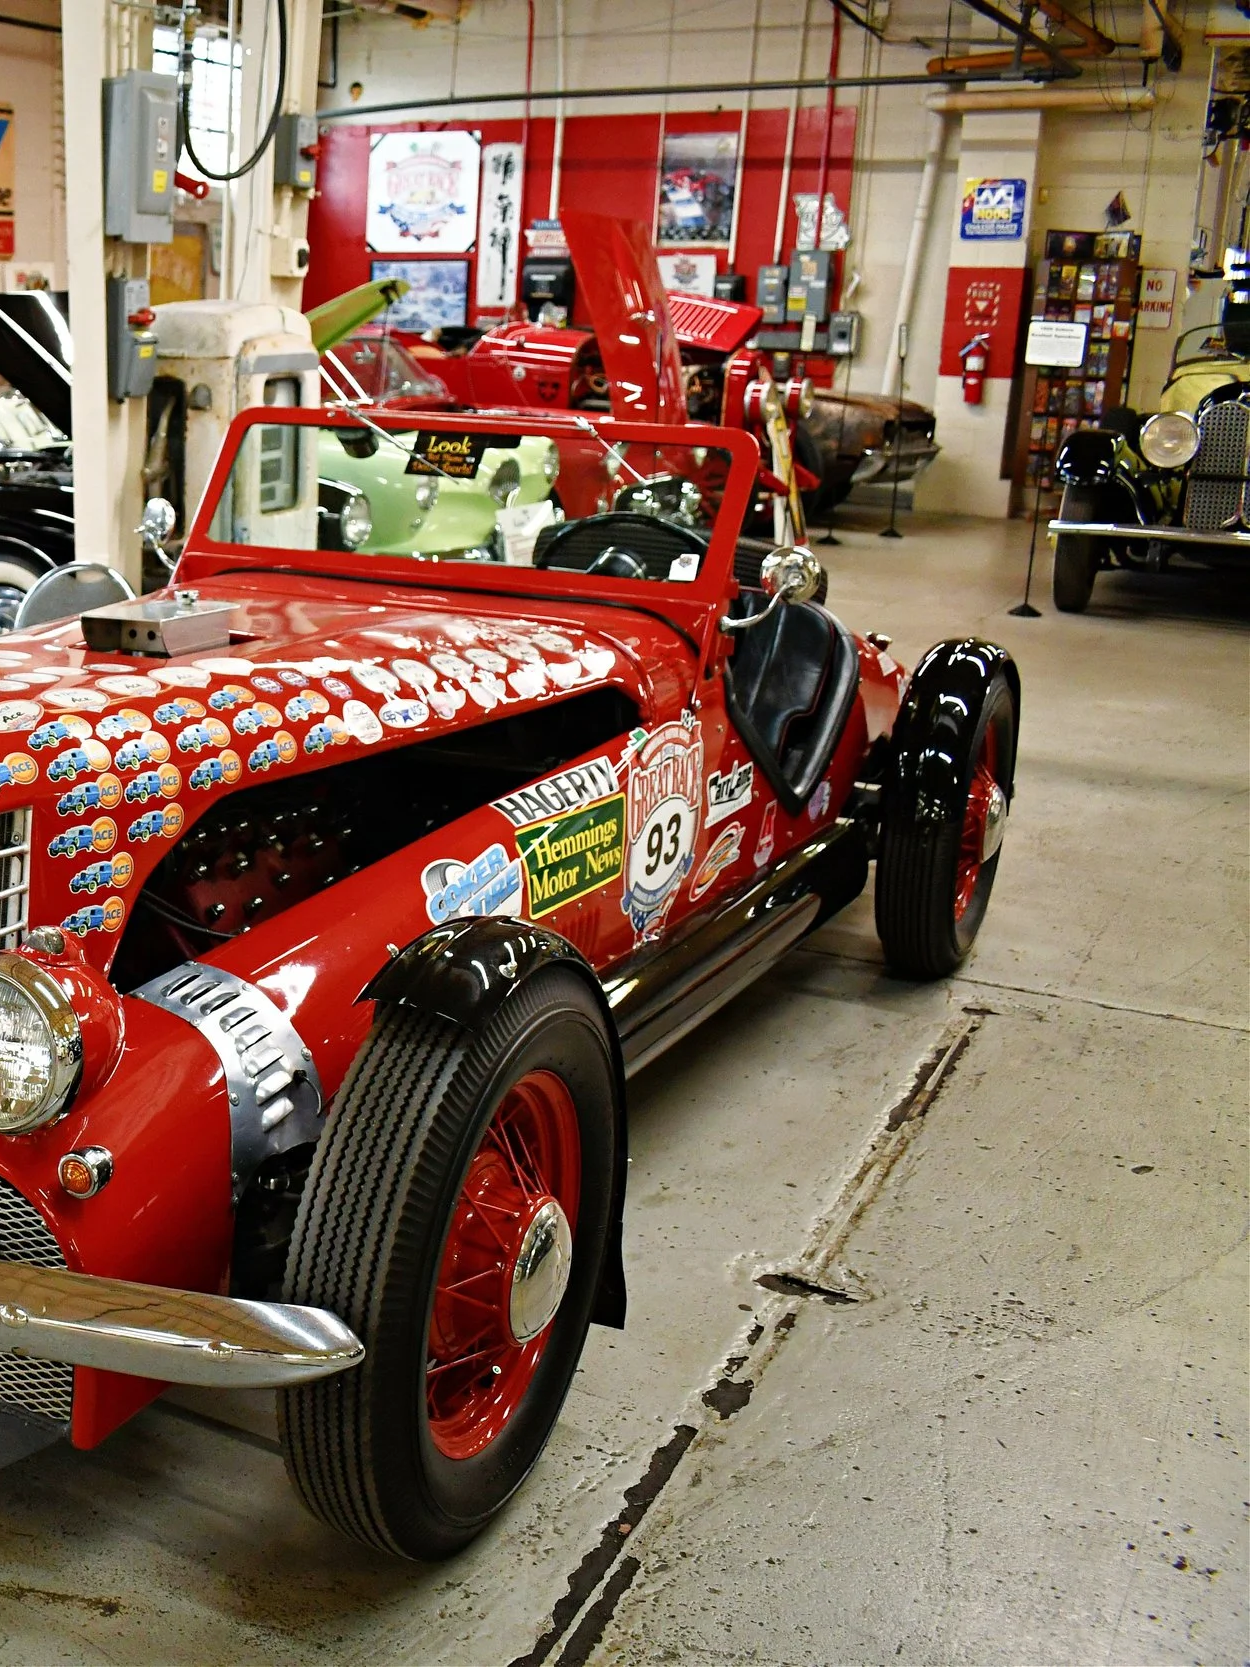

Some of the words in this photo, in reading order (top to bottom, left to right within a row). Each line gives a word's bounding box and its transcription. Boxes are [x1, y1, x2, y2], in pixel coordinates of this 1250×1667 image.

[1146, 279, 1163, 292] NO
[1138, 301, 1171, 313] ARKING
[427, 436, 471, 454] Look
[2, 711, 24, 723] Ace
[279, 741, 294, 752] ACE
[10, 762, 32, 775] ACE
[223, 761, 239, 772] ACE
[161, 776, 178, 787] ACE
[100, 785, 118, 797] ACE
[494, 759, 614, 825] HAGERTY
[632, 758, 674, 838] GREAT
[674, 746, 701, 808] RACE
[163, 815, 180, 826] ACE
[94, 829, 113, 840] ACE
[530, 817, 618, 869] Hemmings
[645, 814, 681, 876] 93
[113, 864, 130, 876] ACE
[531, 866, 580, 905] Motor
[584, 846, 621, 880] News
[430, 847, 508, 923] COKER
[468, 866, 520, 916] TIRE
[105, 908, 121, 920] ACE
